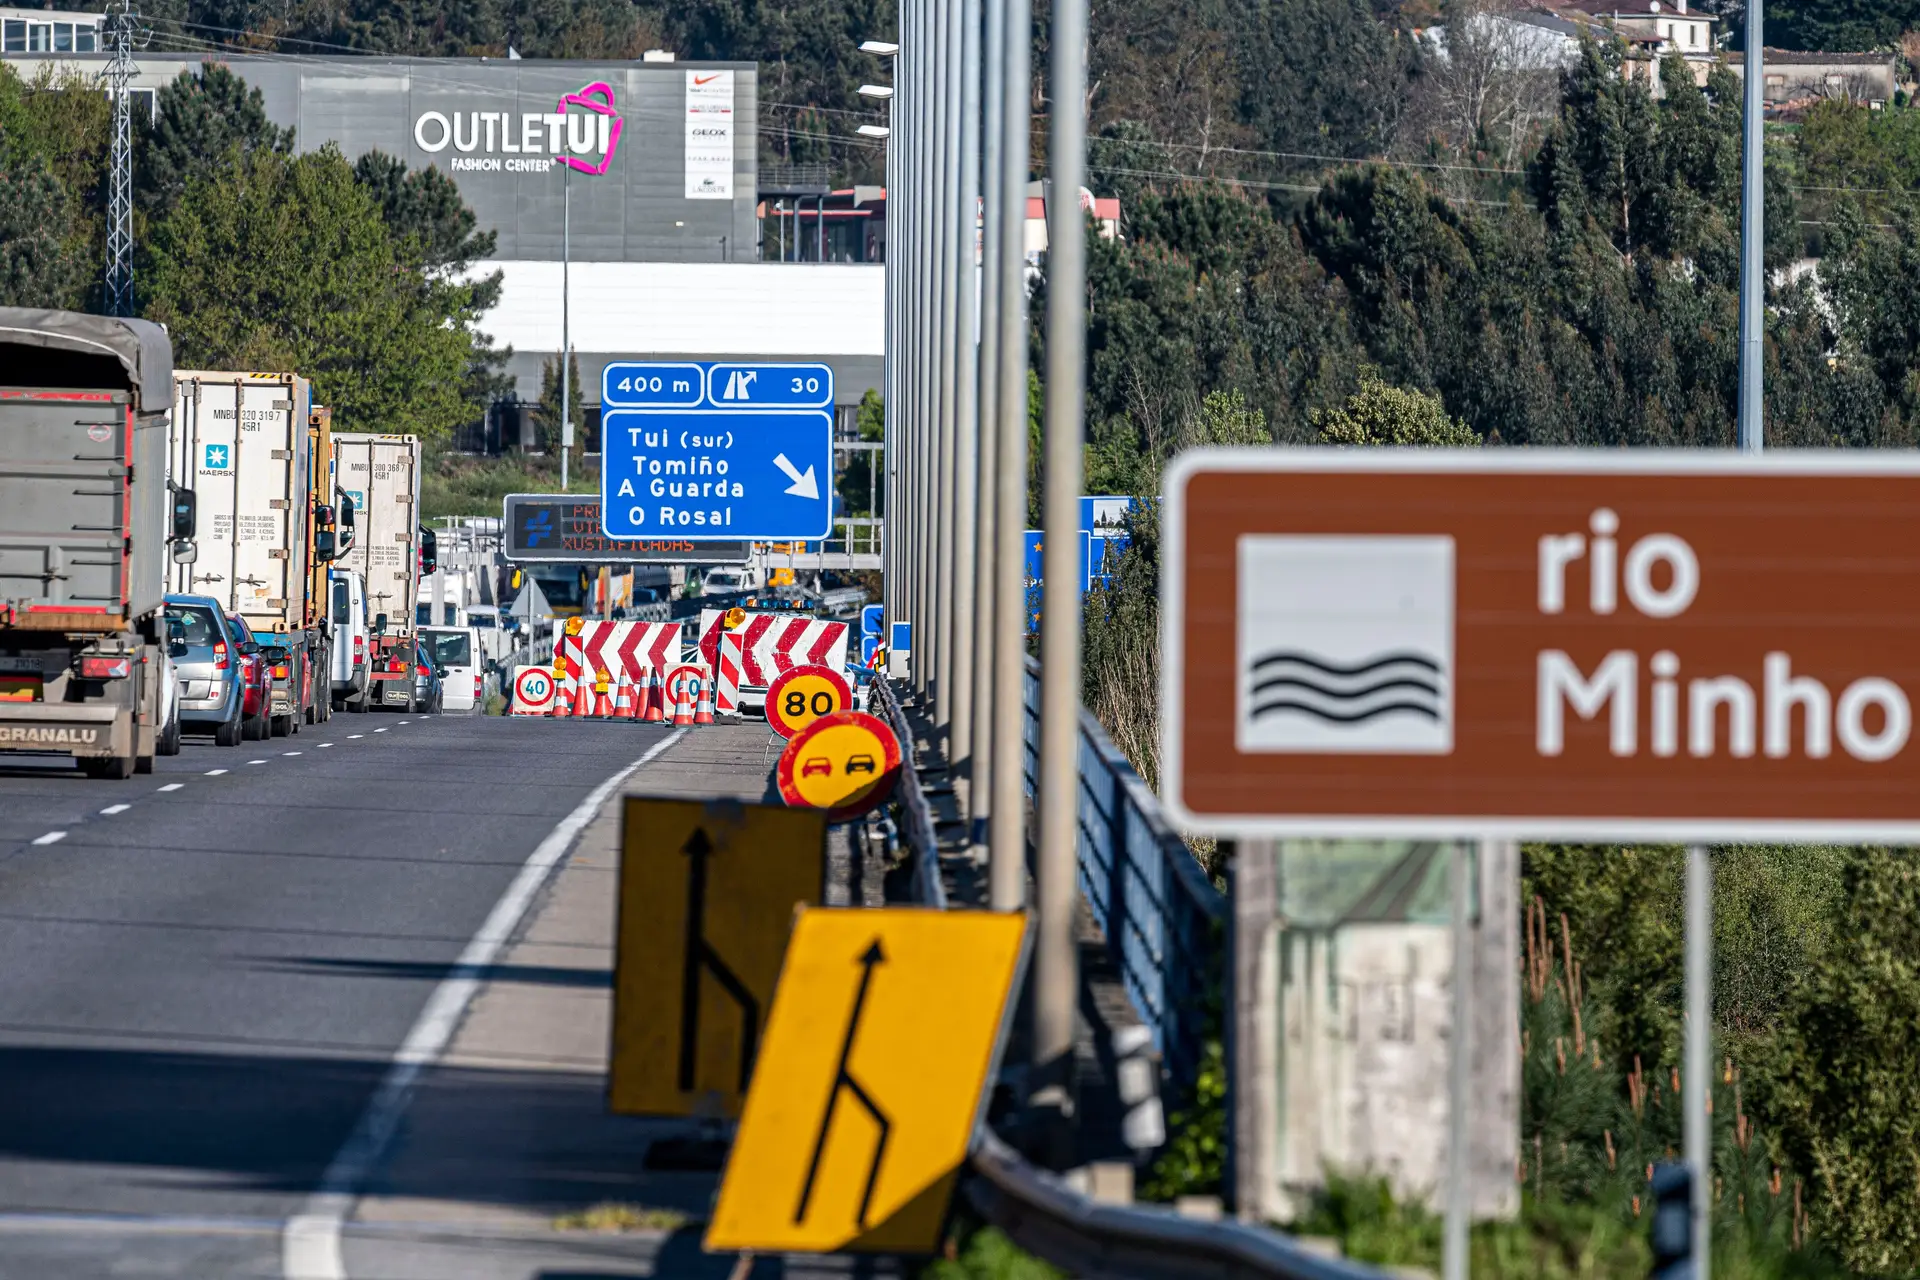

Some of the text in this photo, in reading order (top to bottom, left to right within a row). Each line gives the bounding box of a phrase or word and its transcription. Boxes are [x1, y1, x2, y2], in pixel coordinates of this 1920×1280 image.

[414, 111, 610, 154] OUTLETUI
[692, 128, 726, 136] GEOX
[451, 158, 500, 172] FASHION
[617, 377, 690, 393] 400 m
[791, 378, 819, 393] 30
[213, 409, 237, 420] MNBU
[241, 411, 256, 421] 320
[628, 428, 733, 449] Tui (sur)
[199, 469, 235, 477] MAERSK
[633, 456, 729, 475] Tomiño
[617, 478, 744, 498] A Guarda
[629, 506, 731, 526] O Rosal
[1537, 507, 1700, 619] rio
[525, 680, 545, 695] 40
[785, 691, 833, 717] 80
[1535, 649, 1913, 763] Minho
[0, 727, 98, 744] GRANALU
